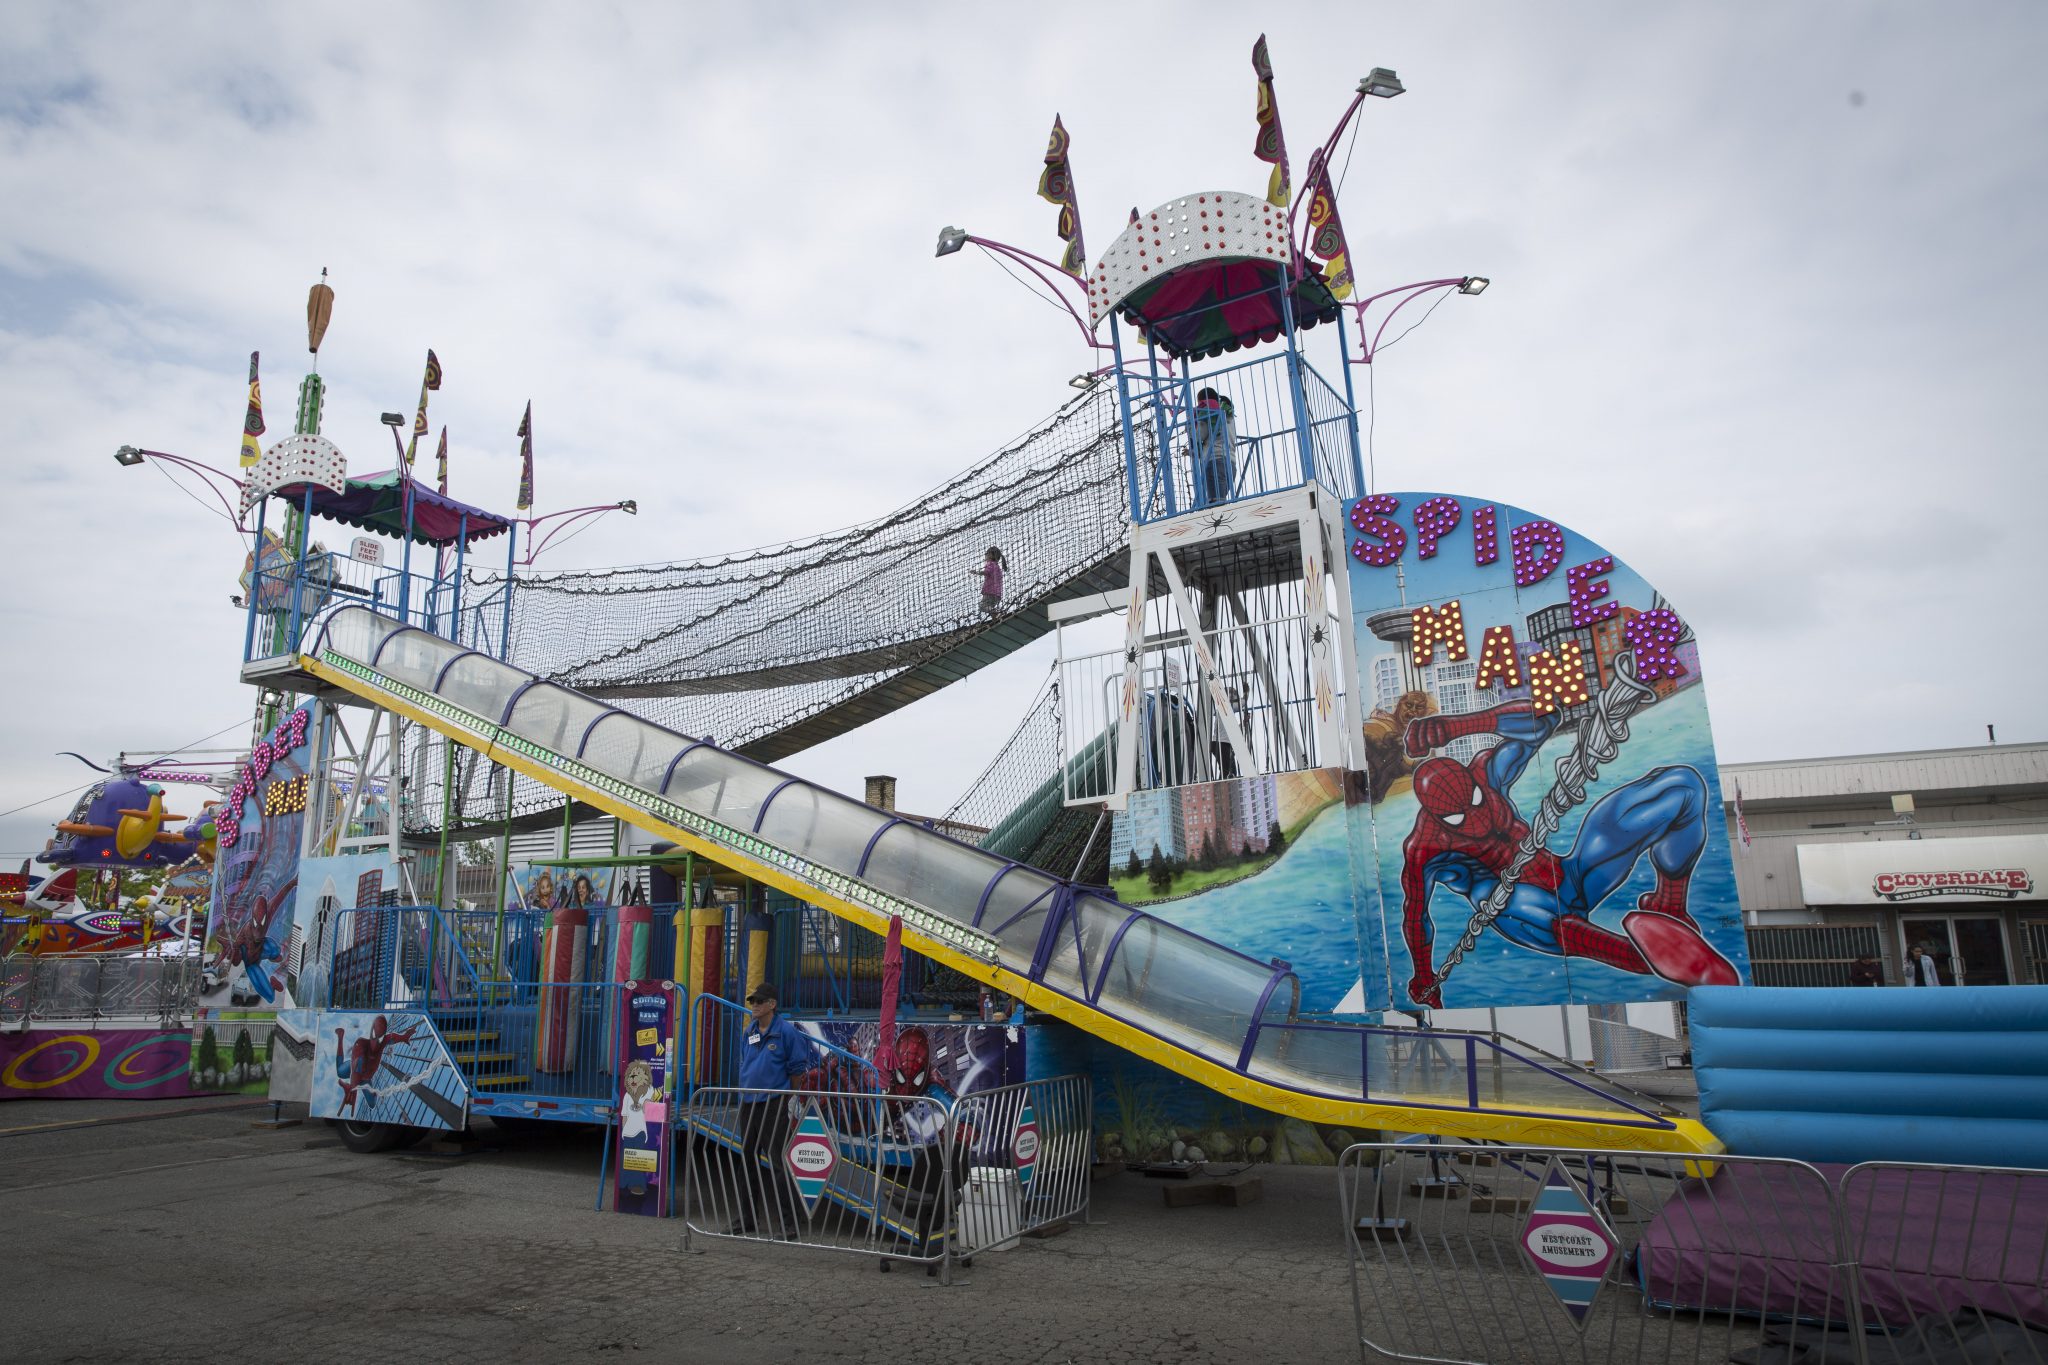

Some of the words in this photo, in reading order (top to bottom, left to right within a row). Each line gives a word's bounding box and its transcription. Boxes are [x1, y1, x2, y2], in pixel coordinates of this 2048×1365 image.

[359, 540, 379, 550] SLIDE
[360, 546, 377, 556] FEET
[358, 552, 378, 562] FIRST
[1350, 493, 1688, 682] SPIDER
[1411, 599, 1590, 718] MAN
[215, 708, 308, 849] SPIDER
[1877, 870, 2028, 893] CLOVERDALE
[1895, 890, 1930, 901] RODEO
[1942, 887, 2009, 897] EXHIBITION
[157, 896, 179, 906] FLY
[1541, 1234, 1564, 1244] WEST
[1565, 1236, 1592, 1246] COAST
[1541, 1246, 1596, 1257] AMUSEMENTS
